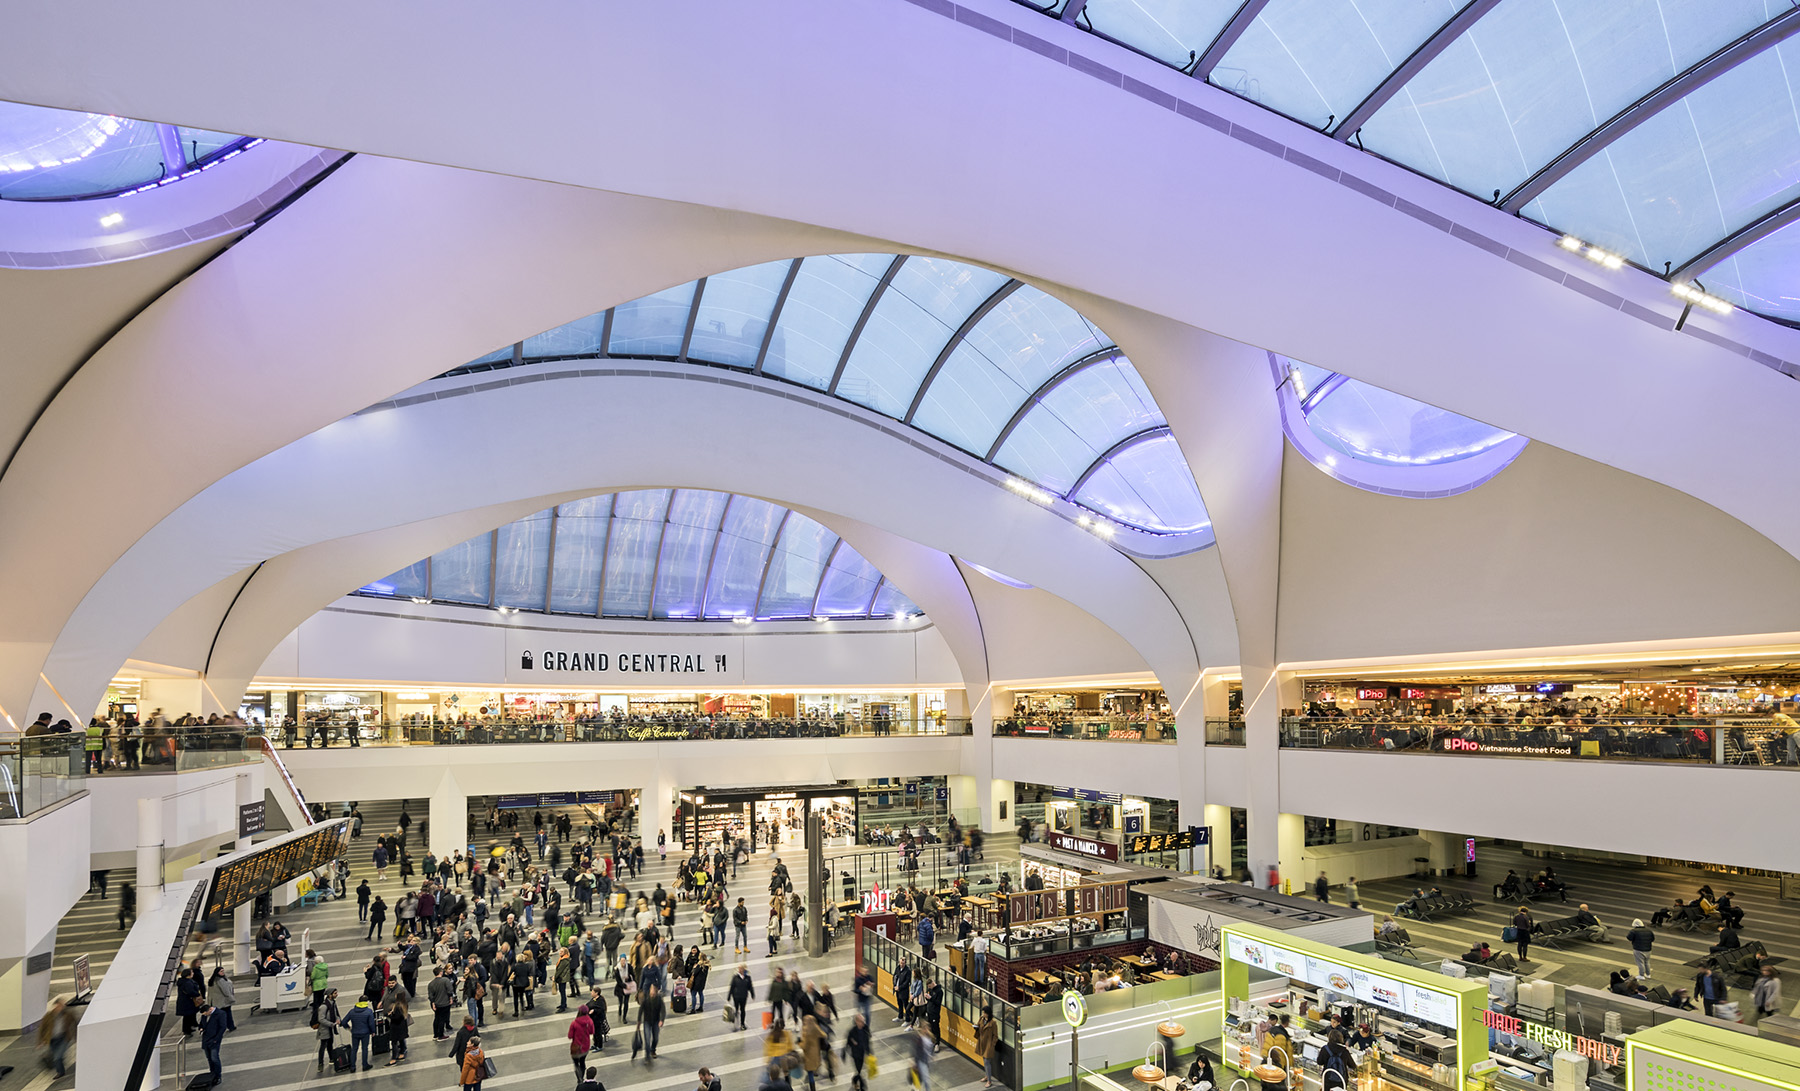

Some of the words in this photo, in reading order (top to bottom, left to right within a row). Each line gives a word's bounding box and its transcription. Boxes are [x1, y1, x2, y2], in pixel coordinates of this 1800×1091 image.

[543, 651, 609, 671] GRAND
[618, 654, 706, 673] CENTRAL
[1365, 689, 1384, 699] Pho
[651, 725, 690, 738] Concerto
[1451, 738, 1478, 751] Pho
[1478, 744, 1522, 753] Vietnamese
[1523, 745, 1548, 754] Street
[1549, 746, 1571, 755] Food
[1131, 820, 1137, 829] 6
[1363, 824, 1371, 841] 6
[1199, 831, 1205, 841] 7
[864, 889, 892, 912] PRET
[1482, 1009, 1522, 1037] MADE
[1525, 1021, 1573, 1052] FRESH
[1576, 1035, 1621, 1066] DAILY
